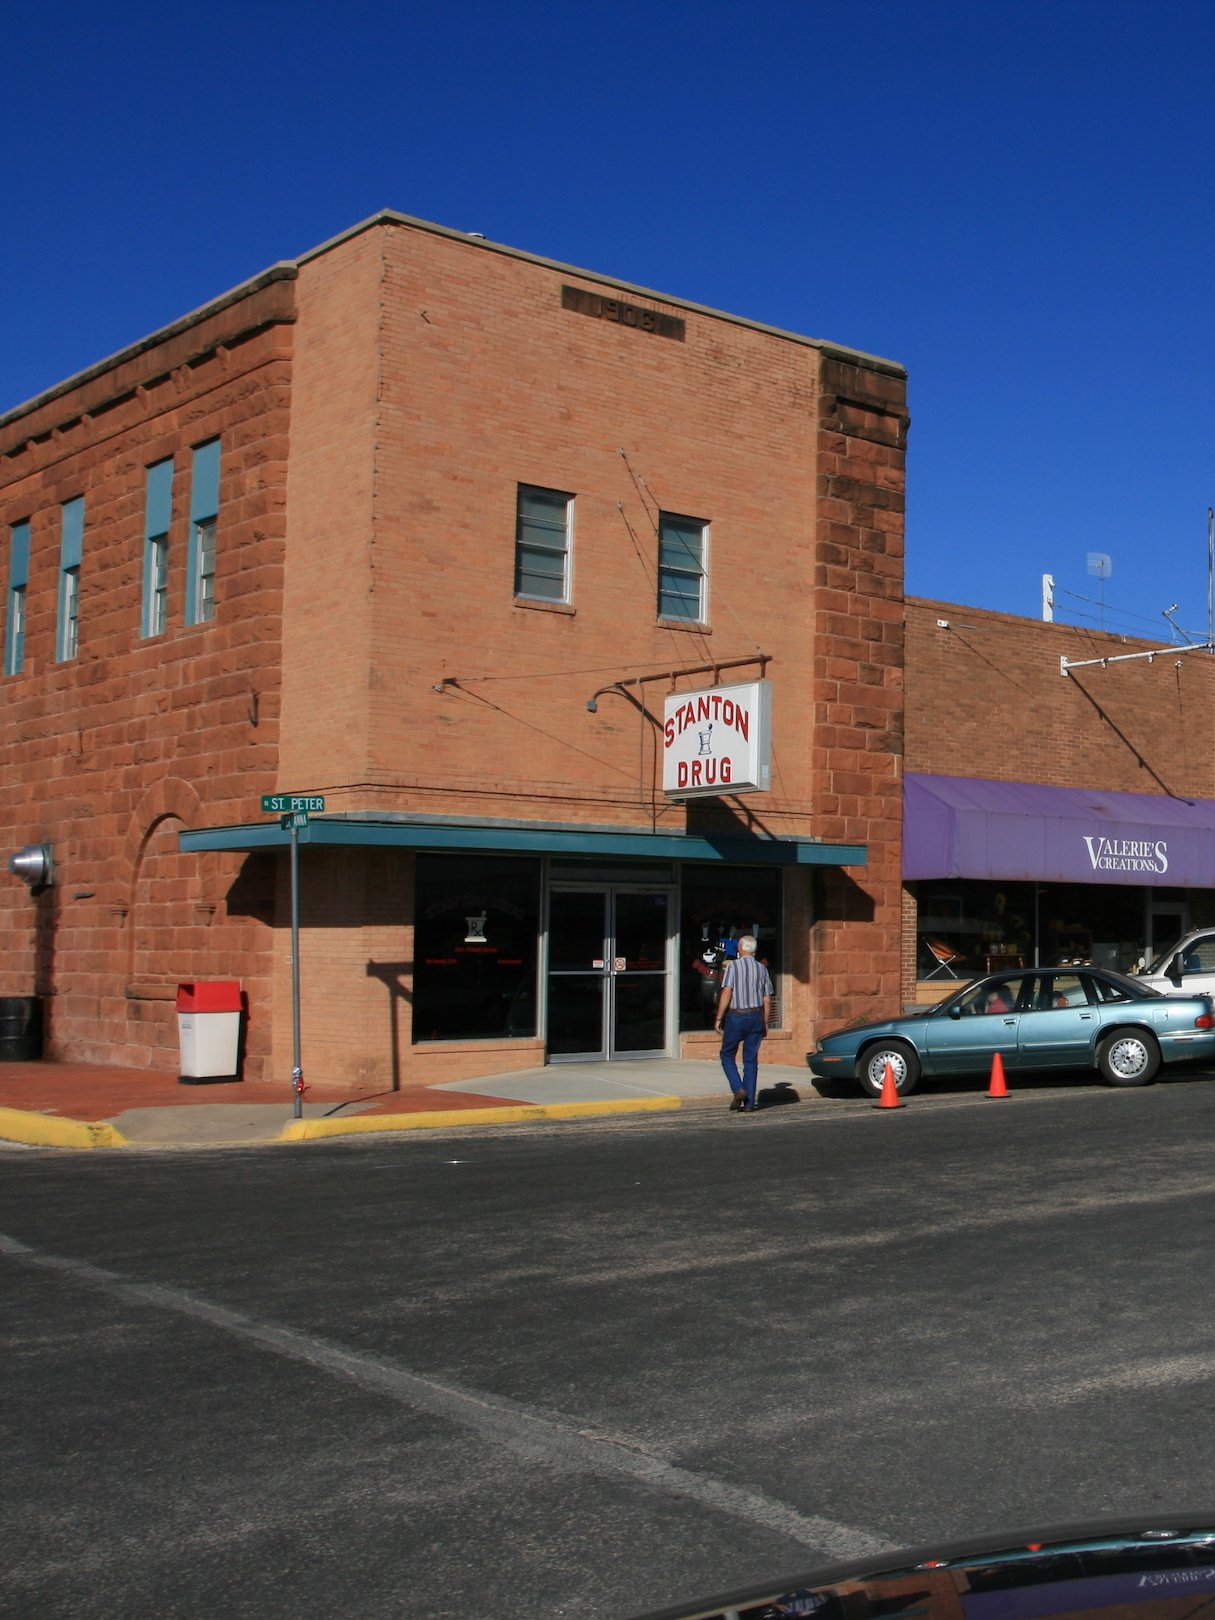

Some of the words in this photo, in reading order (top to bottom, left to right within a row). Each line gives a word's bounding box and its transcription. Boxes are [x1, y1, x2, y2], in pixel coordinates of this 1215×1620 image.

[664, 695, 749, 748] STANTON
[678, 757, 732, 788] DRUG
[291, 798, 323, 810] PETER
[1083, 836, 1168, 874] VALERIE'S
[1099, 857, 1155, 872] CREATIONS
